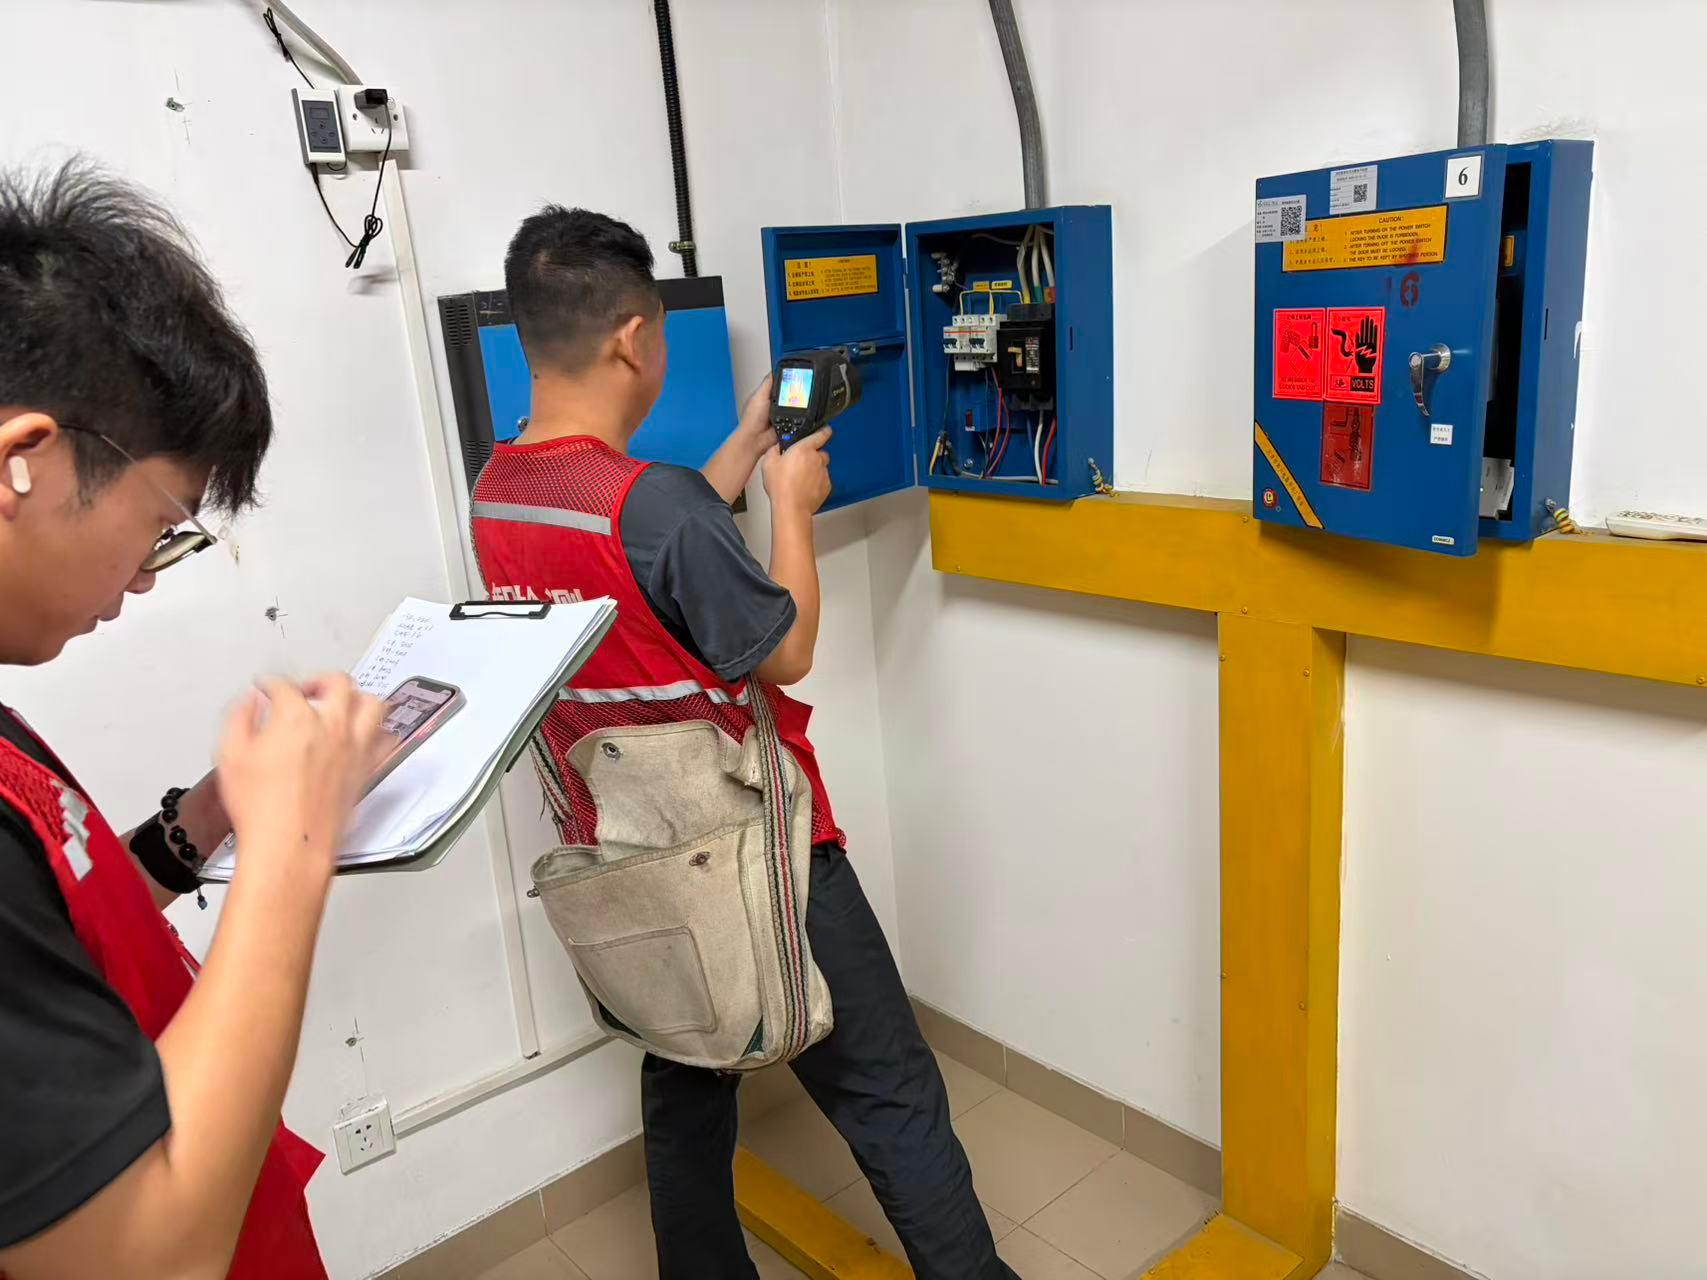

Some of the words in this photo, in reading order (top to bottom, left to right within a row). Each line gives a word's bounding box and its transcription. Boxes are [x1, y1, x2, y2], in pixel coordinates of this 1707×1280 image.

[1458, 166, 1469, 185] 6
[1401, 272, 1420, 307] 6
[1352, 379, 1374, 389] VOLTS
